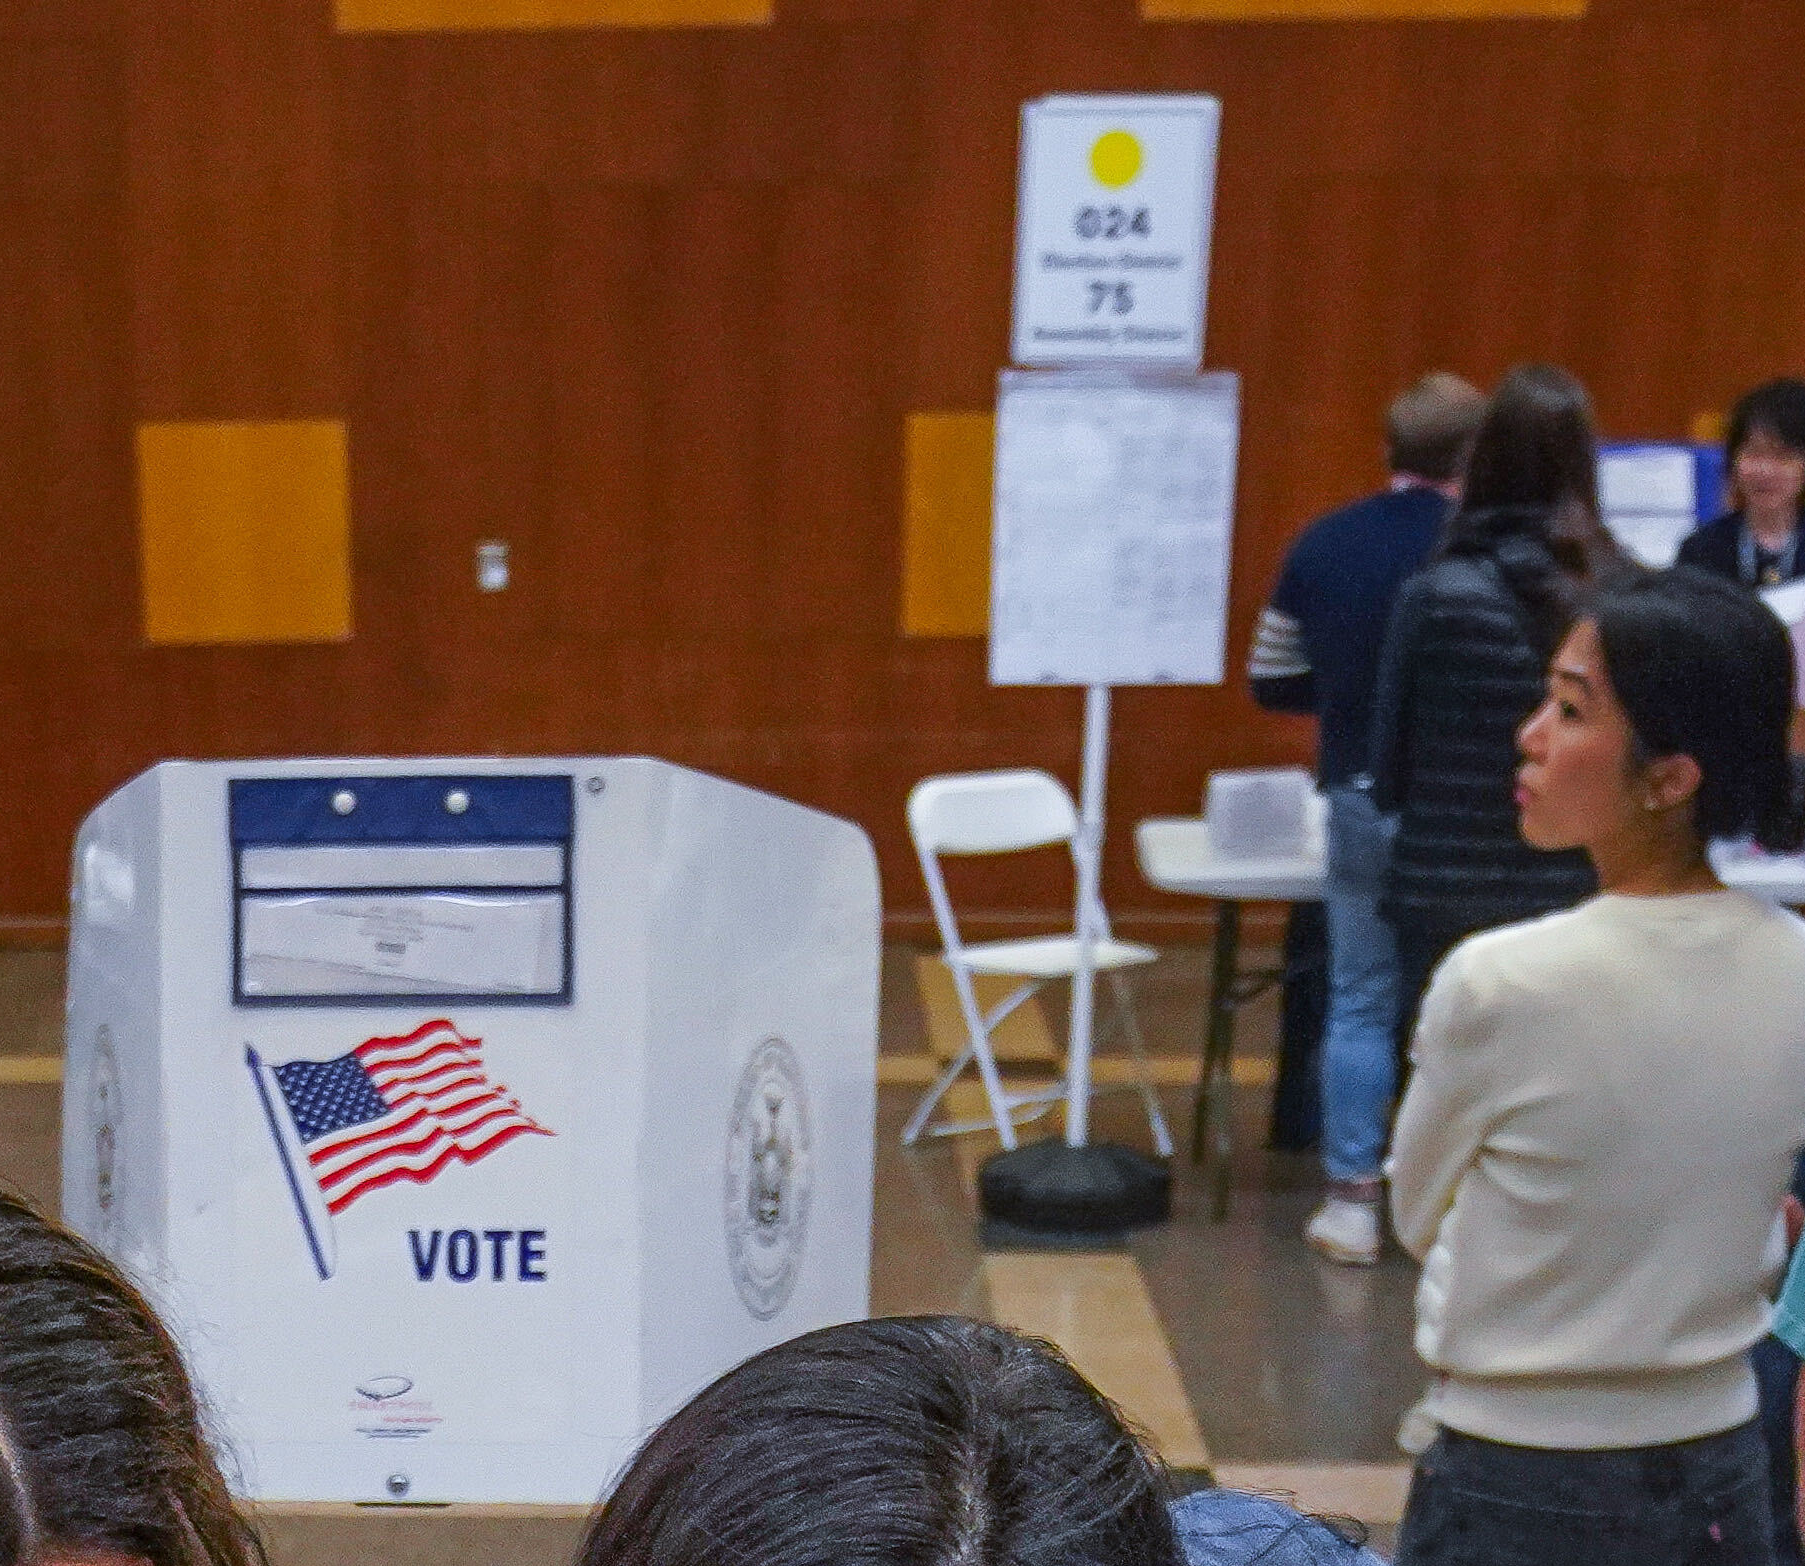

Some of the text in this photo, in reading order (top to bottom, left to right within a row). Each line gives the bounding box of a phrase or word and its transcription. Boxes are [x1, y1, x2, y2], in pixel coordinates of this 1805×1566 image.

[1074, 204, 1151, 239] 024
[1086, 280, 1136, 315] 75
[407, 1229, 547, 1282] VOTE
